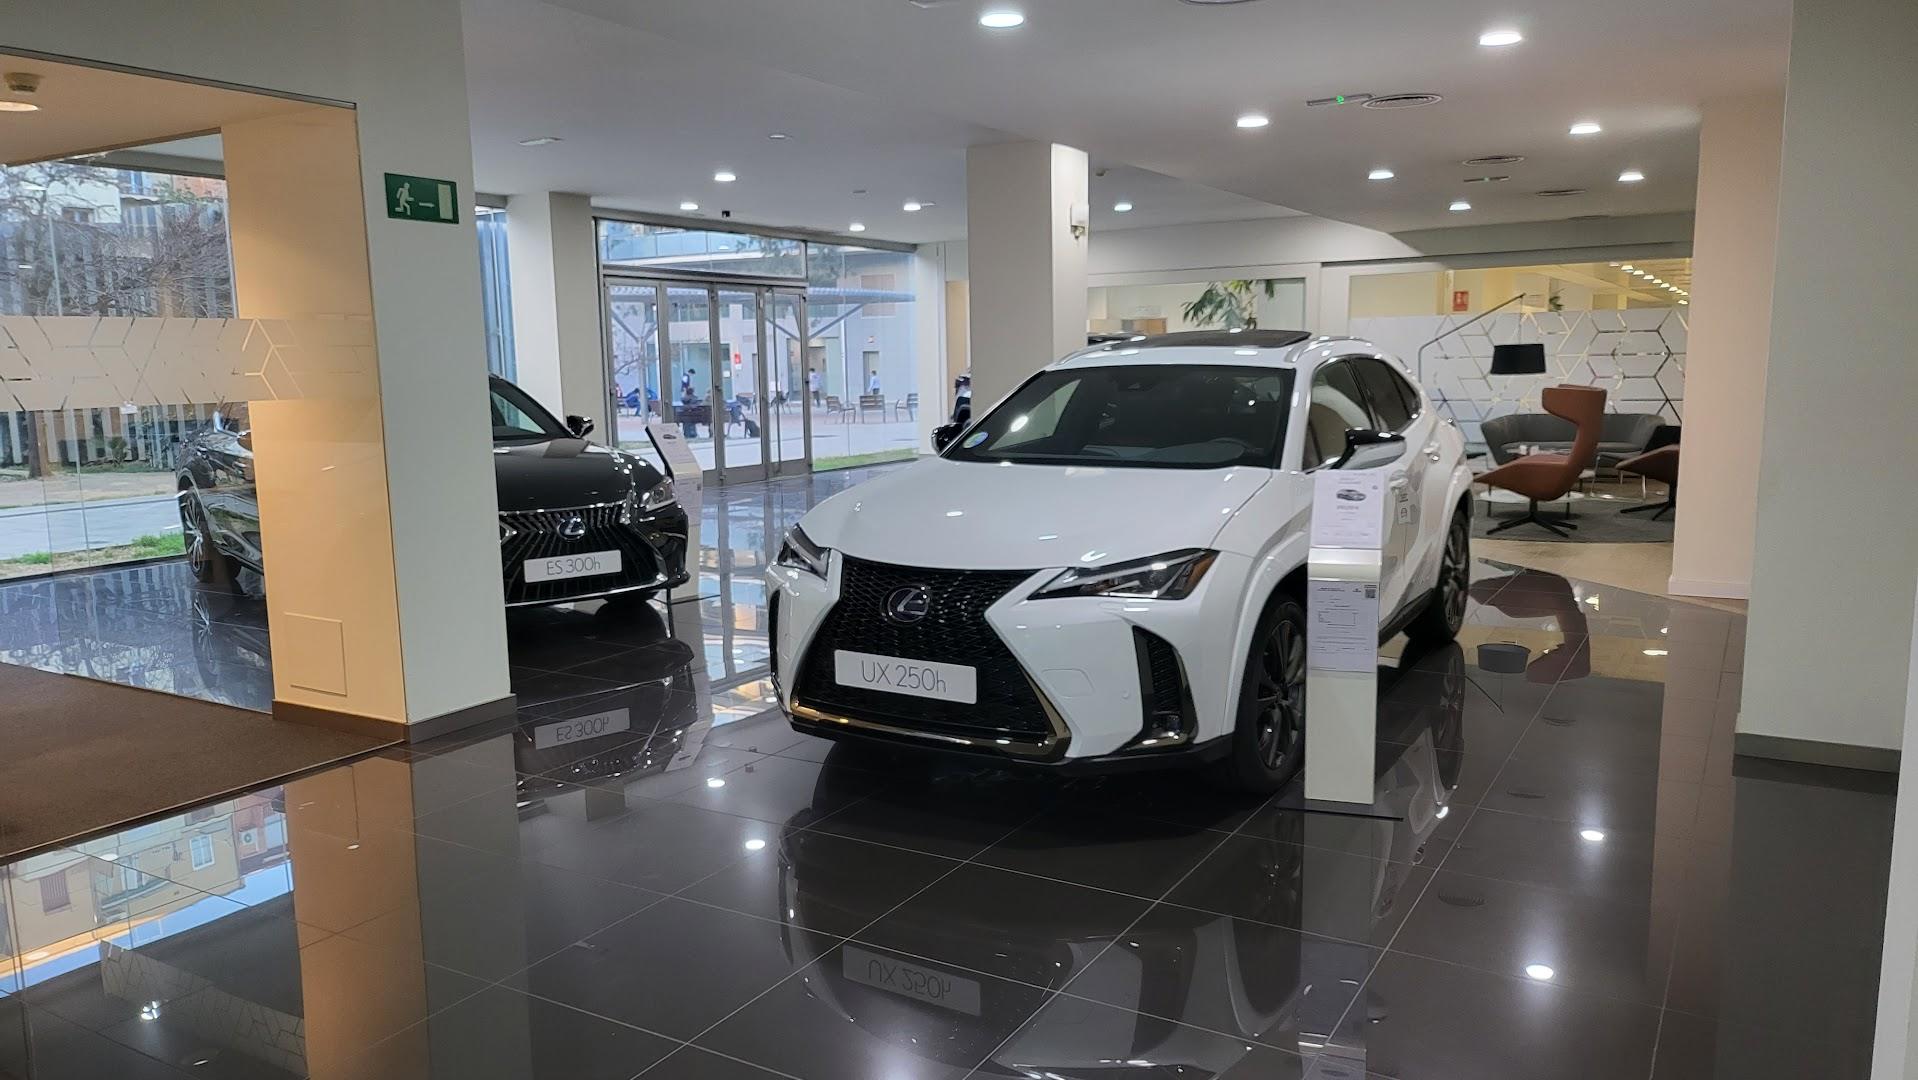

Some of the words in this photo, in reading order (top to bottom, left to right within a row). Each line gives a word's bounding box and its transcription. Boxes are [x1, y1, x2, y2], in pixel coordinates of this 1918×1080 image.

[546, 560, 563, 576] ES
[565, 556, 601, 574] 300h
[861, 659, 892, 686] UX
[895, 664, 947, 693] 250h
